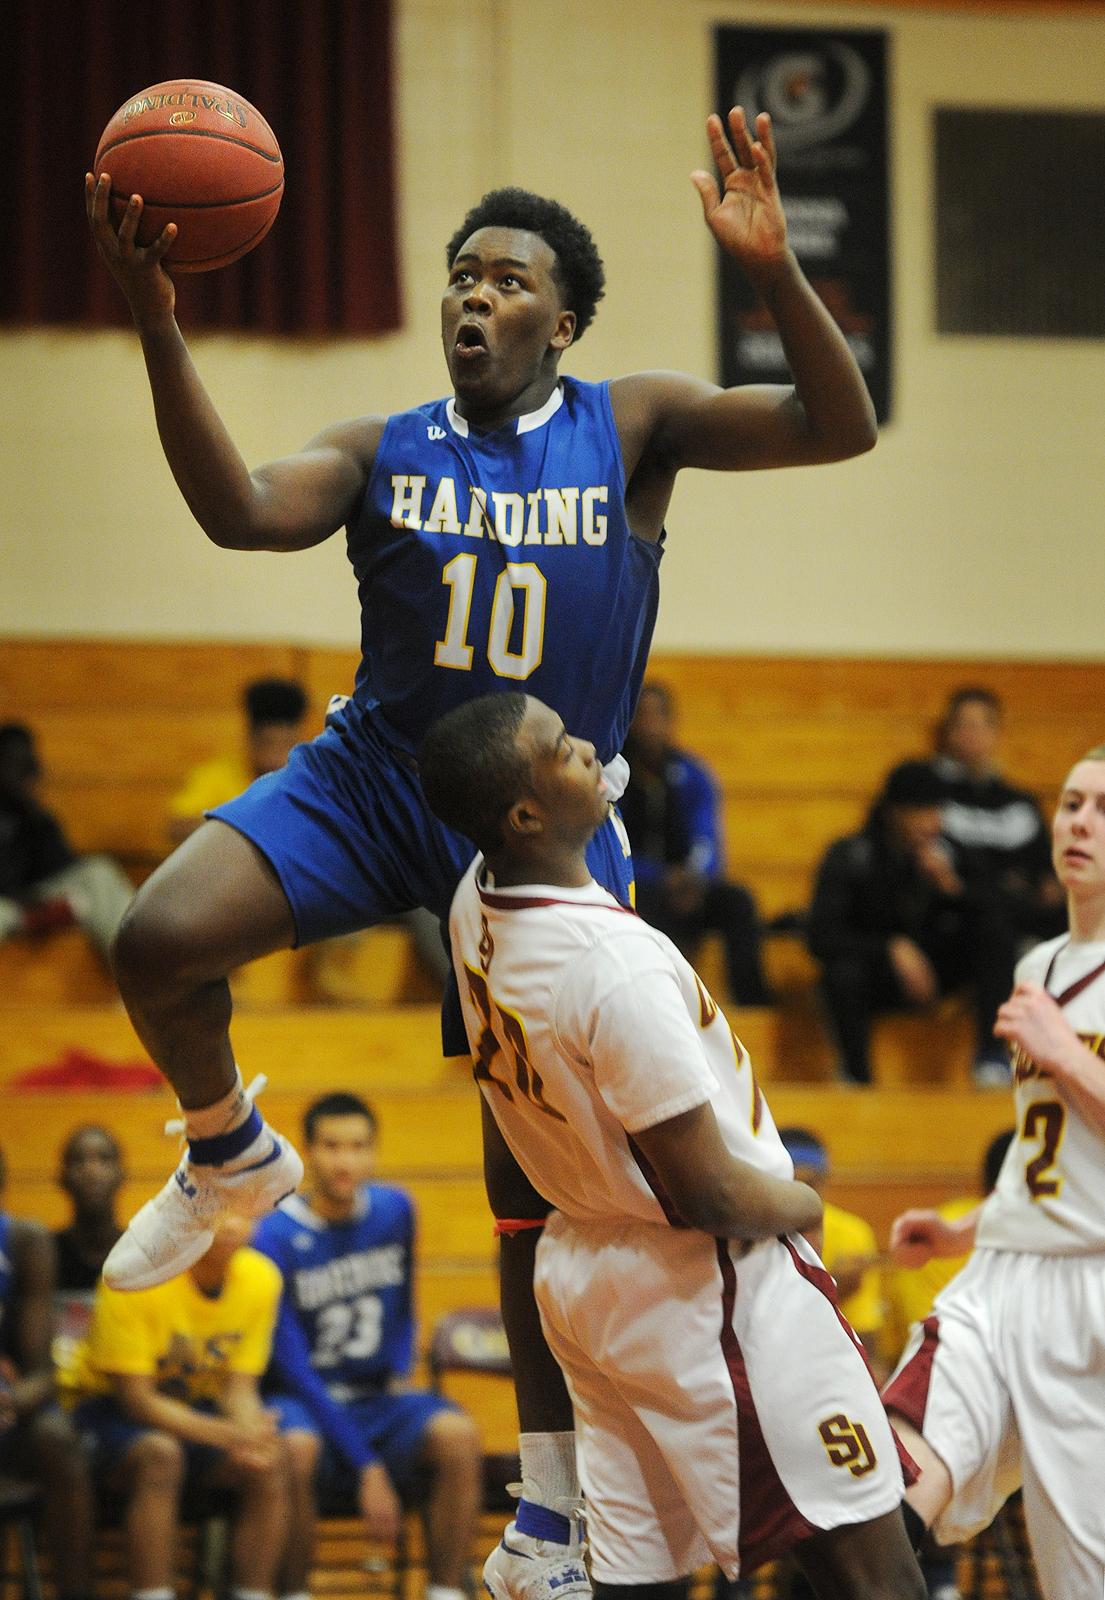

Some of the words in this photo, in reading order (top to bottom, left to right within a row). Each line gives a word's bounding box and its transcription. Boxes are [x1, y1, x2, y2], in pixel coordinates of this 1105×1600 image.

[433, 552, 547, 680] 10
[1020, 1100, 1067, 1202] 2
[311, 1295, 385, 1369] 23
[817, 1412, 877, 1478] SJ
